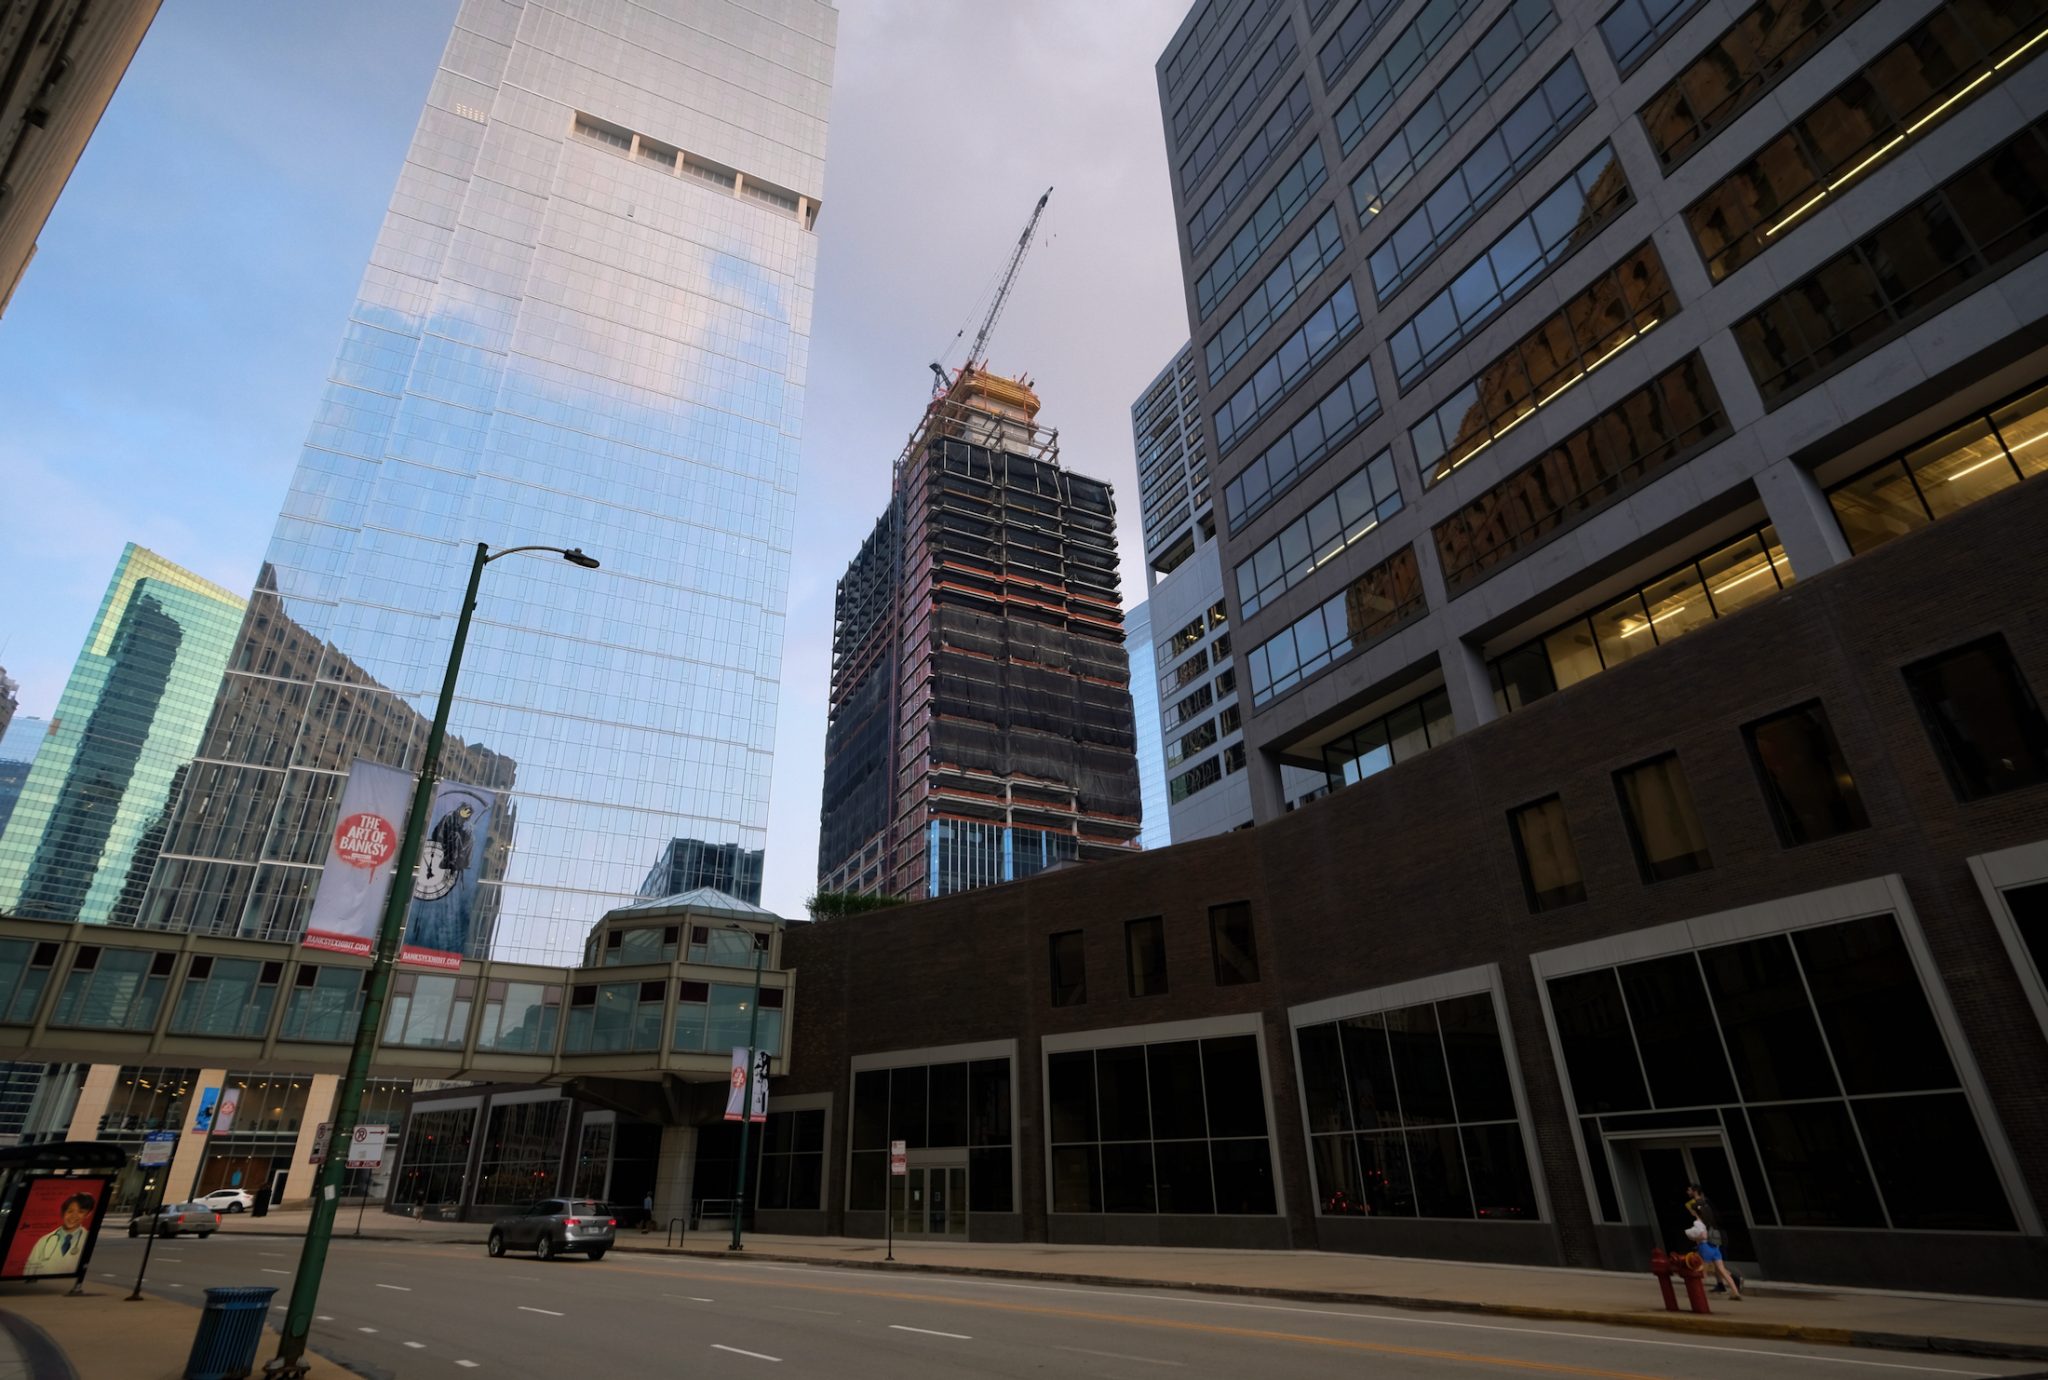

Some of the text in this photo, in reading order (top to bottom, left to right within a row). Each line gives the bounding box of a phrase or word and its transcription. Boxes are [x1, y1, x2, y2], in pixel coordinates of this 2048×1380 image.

[360, 815, 381, 830] THE
[347, 825, 387, 844] ART OF
[339, 836, 388, 857] BANKSY
[306, 935, 370, 952] BANKSYEXHIBIT.COM
[402, 951, 460, 966] BANKSYEXHIBIT.COM
